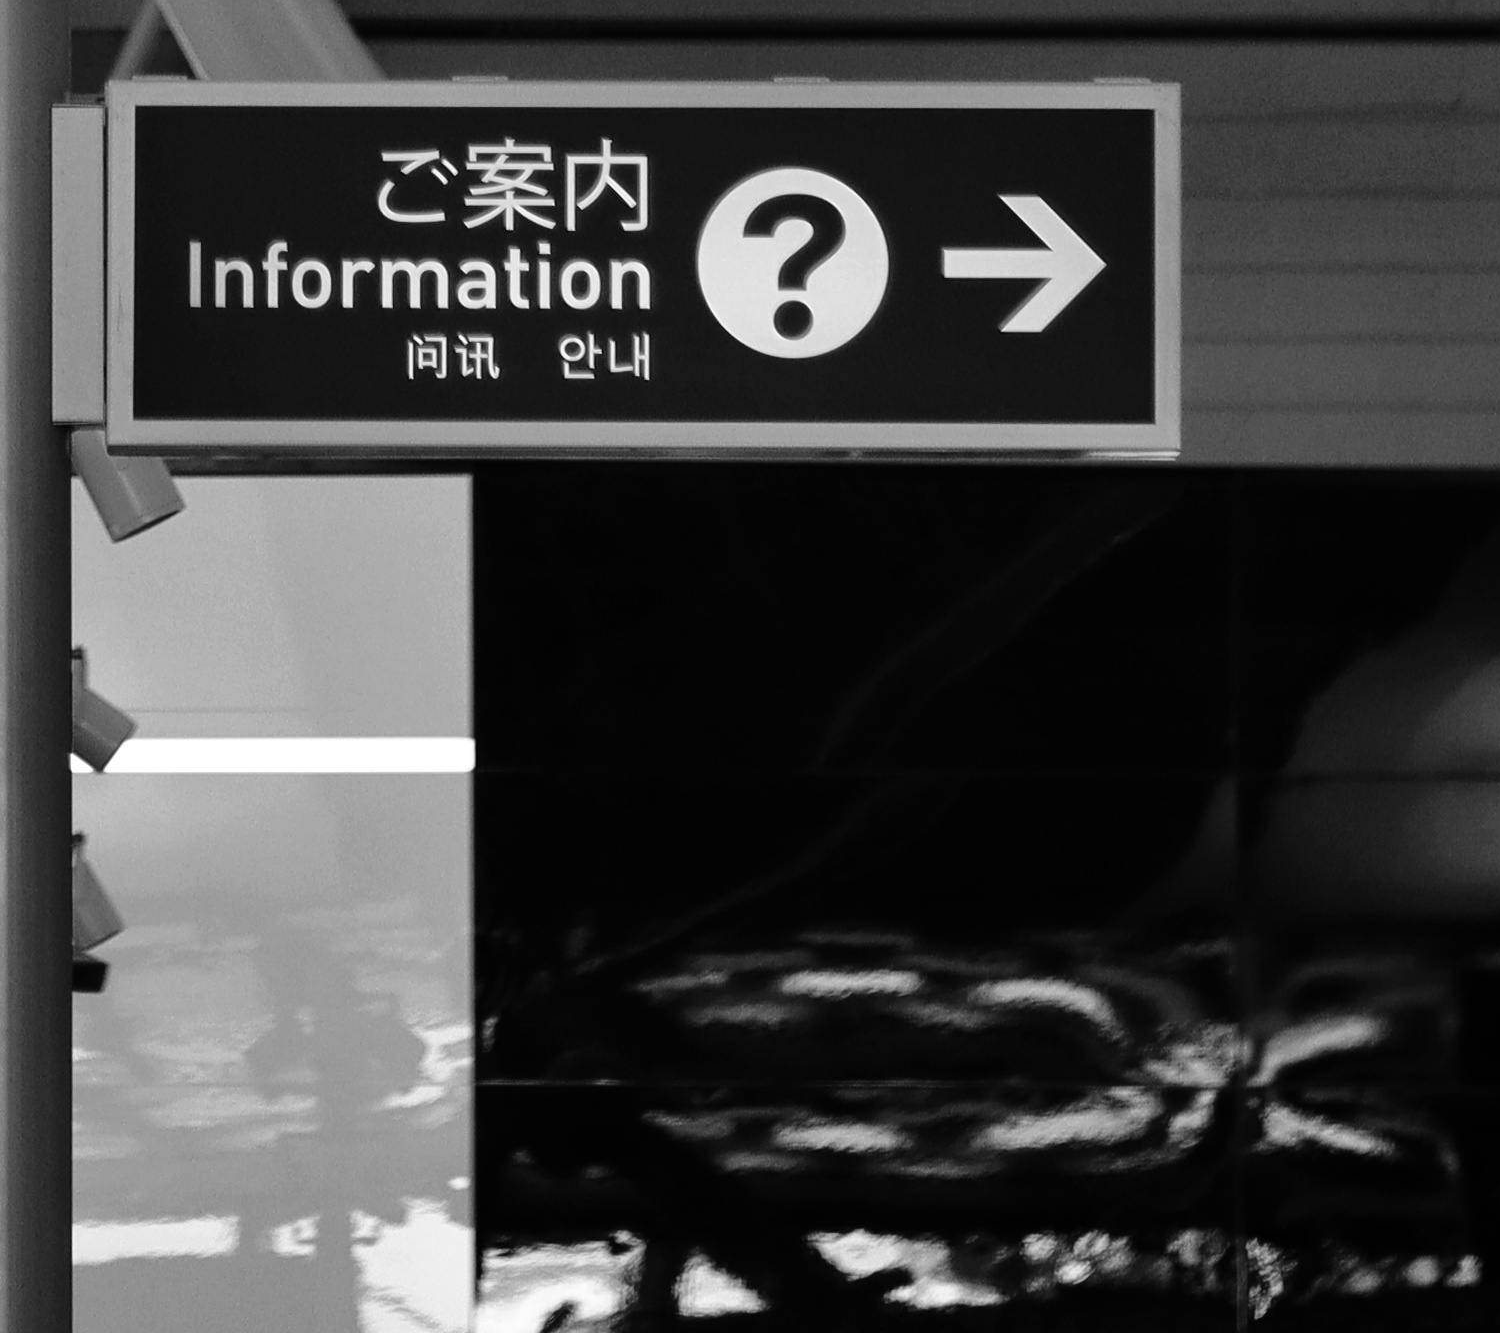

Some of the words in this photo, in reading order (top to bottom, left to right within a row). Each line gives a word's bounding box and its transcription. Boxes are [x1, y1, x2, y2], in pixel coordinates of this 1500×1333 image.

[377, 136, 650, 232] ご案内
[188, 239, 652, 311] Information
[406, 331, 502, 381] 问讯
[557, 331, 651, 381] 안내
